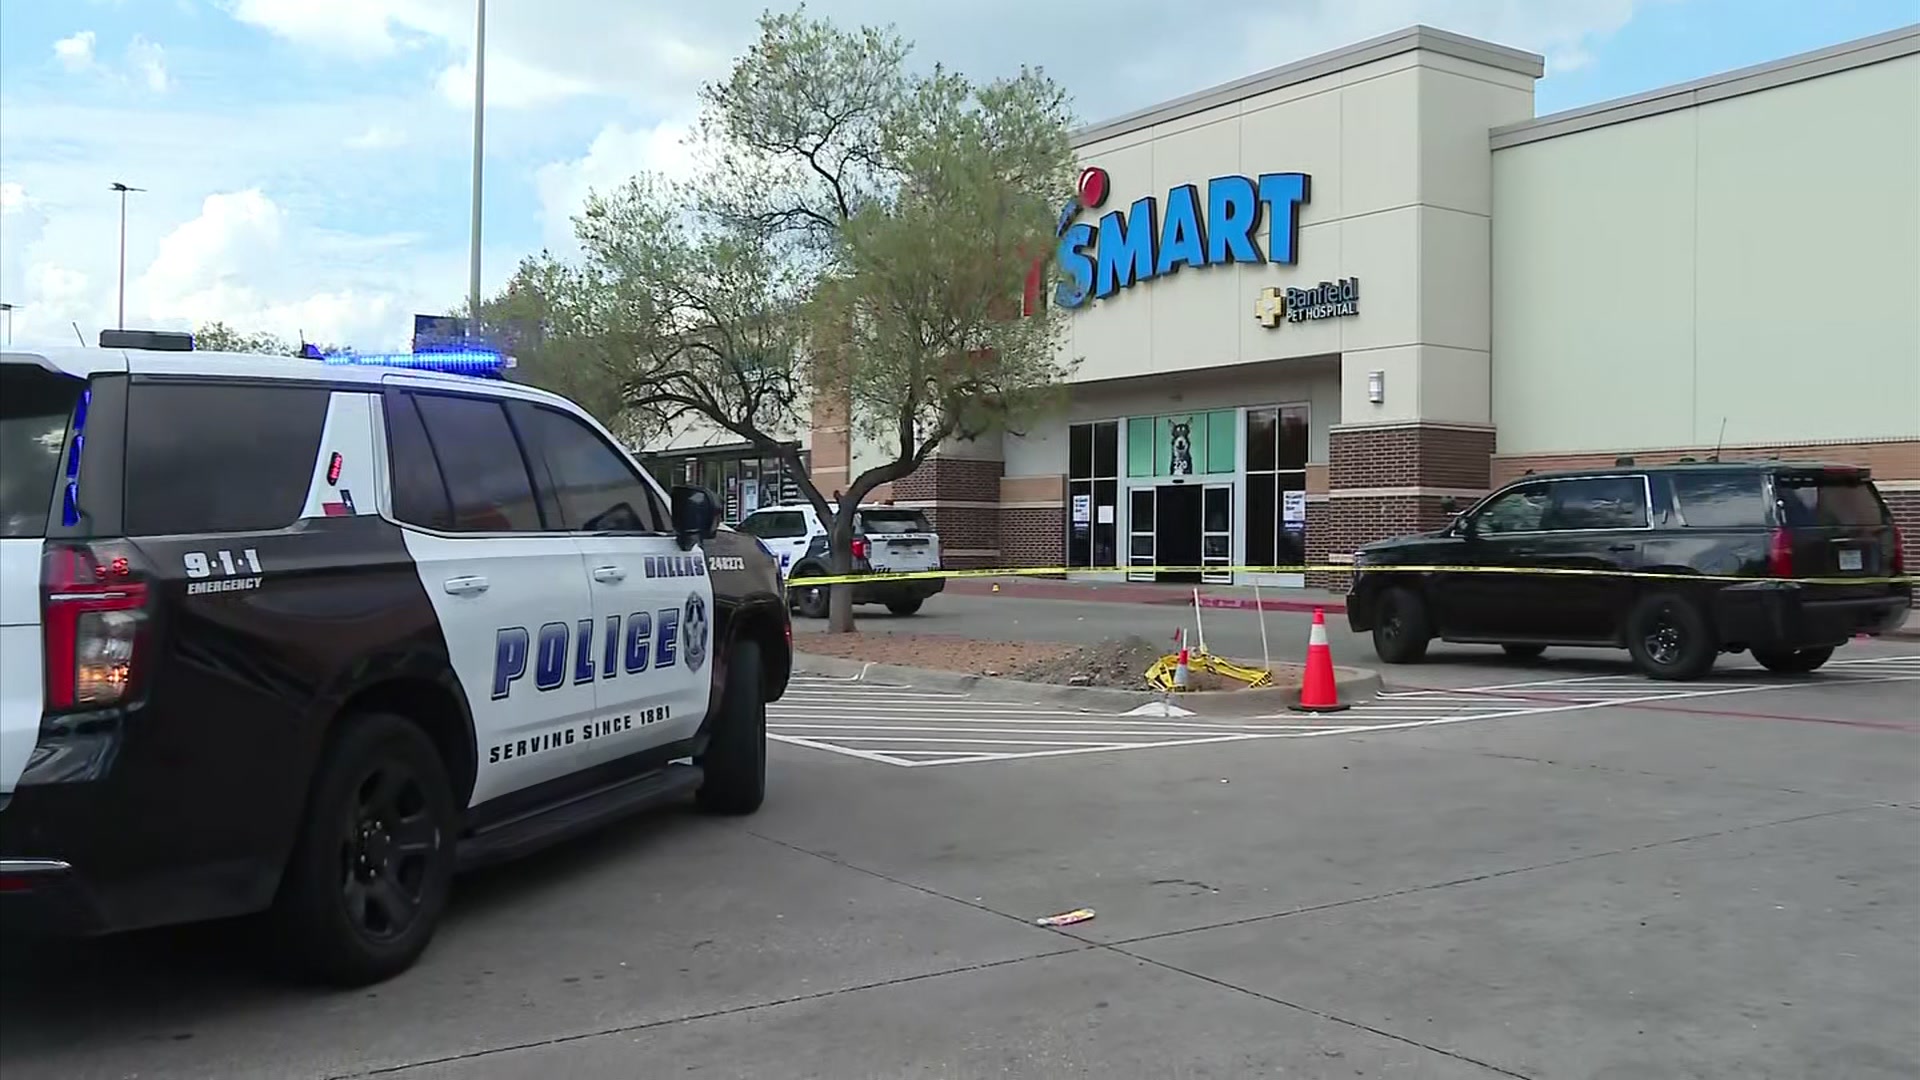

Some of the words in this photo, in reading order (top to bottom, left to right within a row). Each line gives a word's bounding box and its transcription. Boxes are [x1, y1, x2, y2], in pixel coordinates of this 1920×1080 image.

[1286, 277, 1359, 308] Banfield
[1287, 308, 1304, 322] PET
[1306, 302, 1357, 320] HOSPITAL
[643, 555, 705, 578] DALLAS
[187, 577, 262, 595] EMERGENCY
[491, 607, 680, 700] POLICE
[489, 728, 575, 764] SERVING
[583, 715, 631, 740] SINCE
[640, 705, 671, 726] 1881
